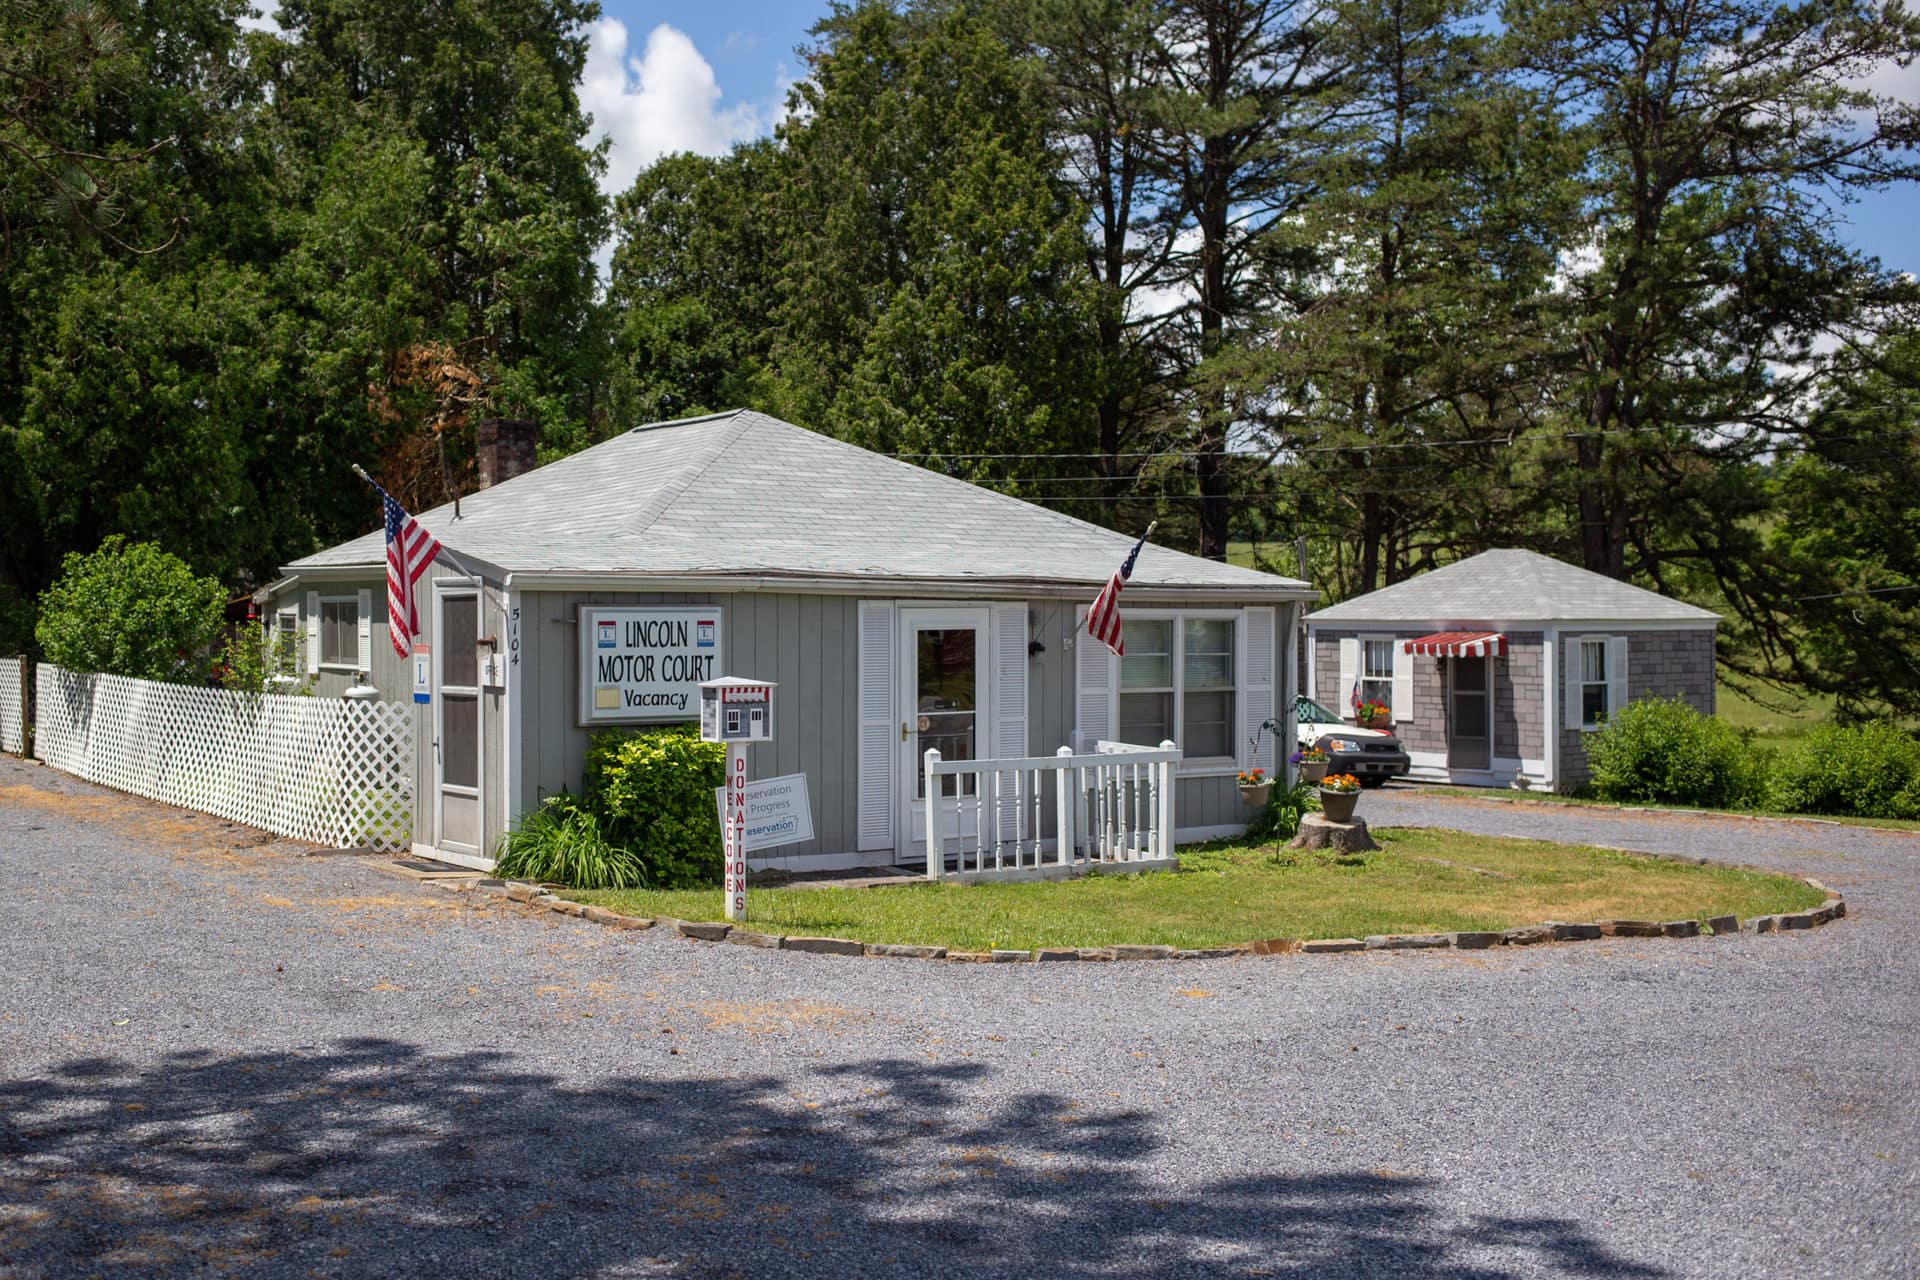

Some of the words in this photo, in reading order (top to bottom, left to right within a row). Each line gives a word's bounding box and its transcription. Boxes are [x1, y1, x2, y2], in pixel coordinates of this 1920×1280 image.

[511, 607, 520, 666] 5104
[626, 620, 688, 648] LINCOLN
[418, 663, 425, 684] L
[599, 655, 655, 683] MOTOR
[661, 655, 714, 682] COURT
[624, 689, 688, 711] Vacancy
[746, 784, 791, 801] eservation
[751, 799, 791, 814] Progress
[736, 758, 745, 910] DONATIONS
[746, 820, 793, 836] eservation
